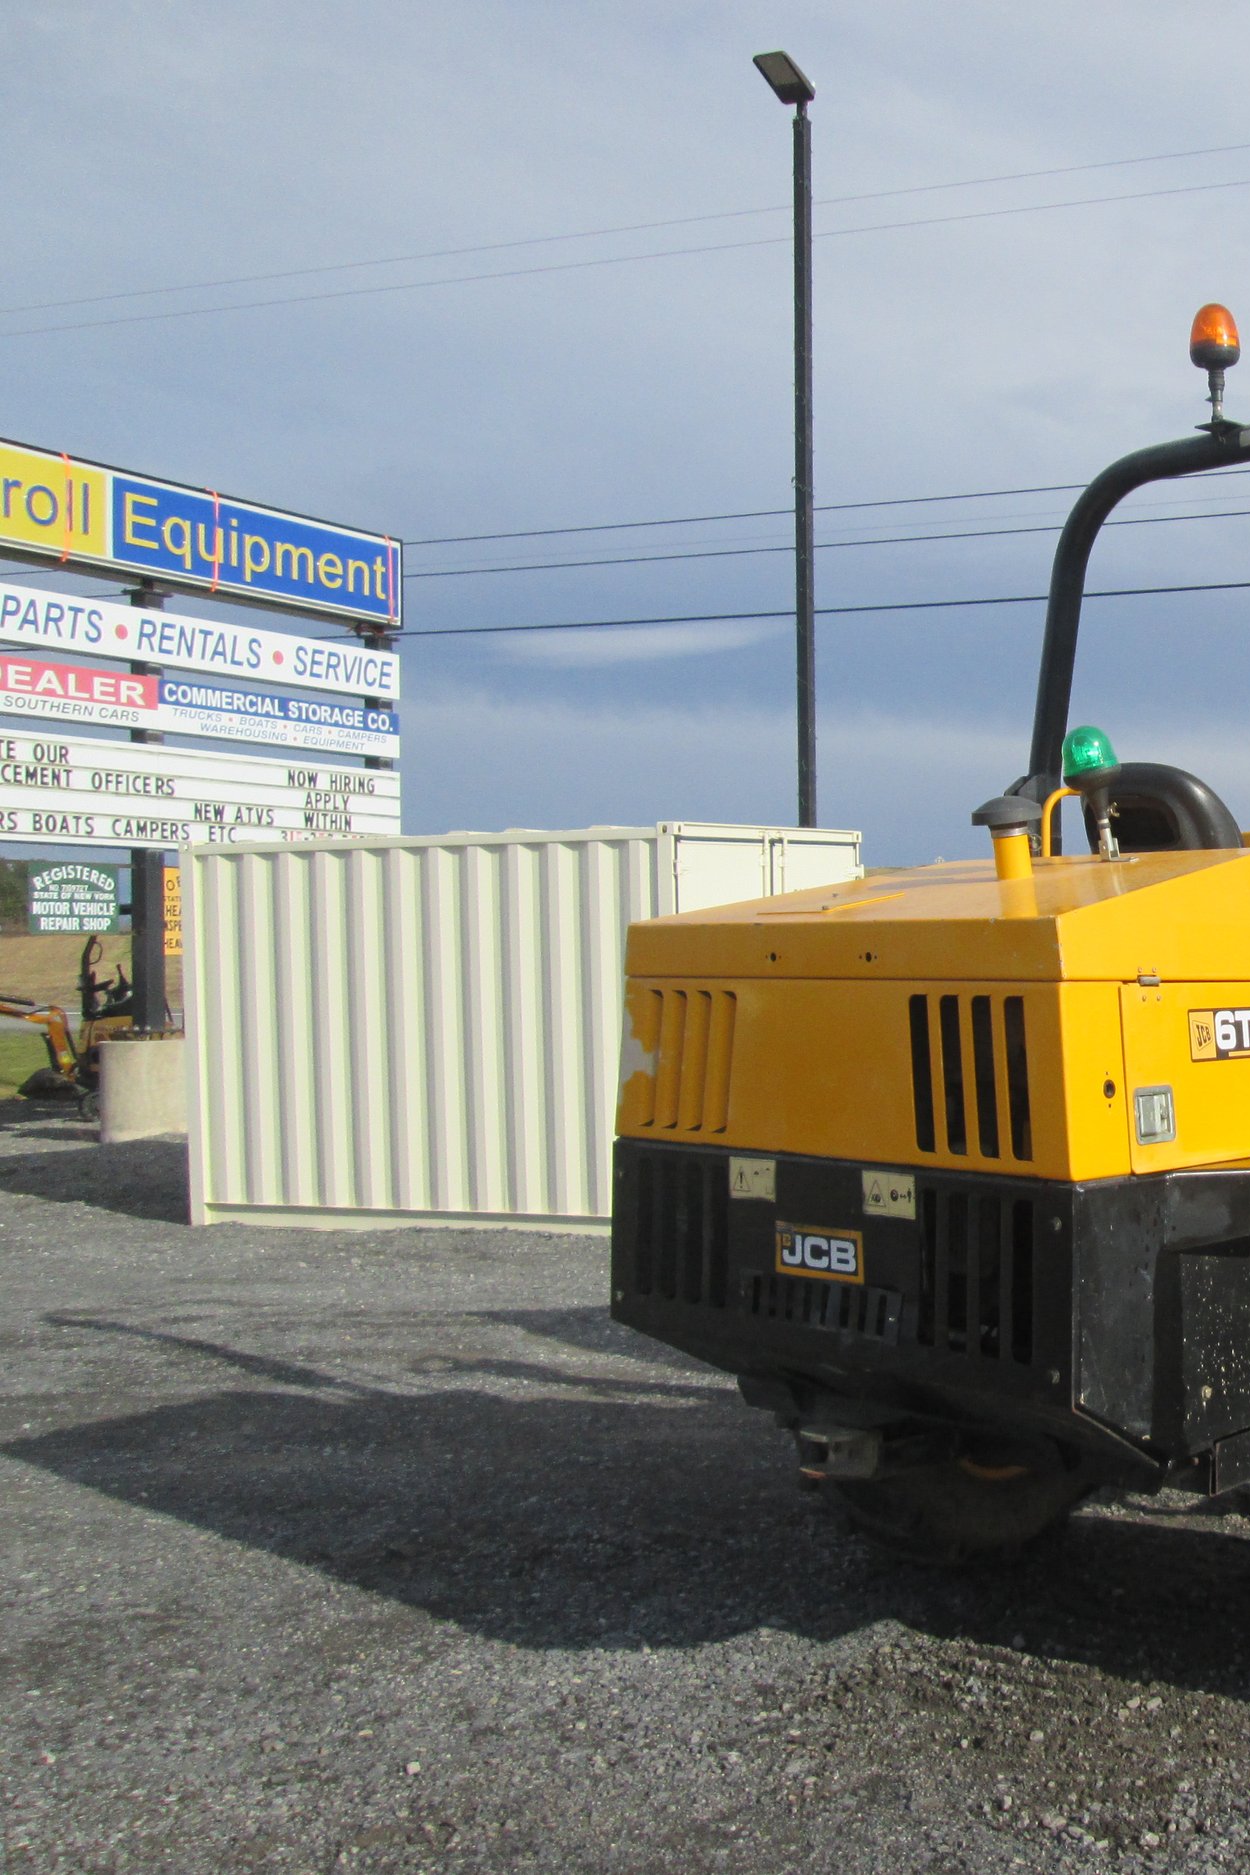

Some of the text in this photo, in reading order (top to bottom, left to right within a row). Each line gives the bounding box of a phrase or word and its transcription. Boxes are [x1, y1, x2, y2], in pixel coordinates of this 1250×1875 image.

[123, 492, 386, 600] Equipment
[0, 593, 393, 690] PARTS RENTALS SERVICE
[0, 664, 145, 706] EALER
[3, 695, 140, 723] SOUTHERN CARS
[164, 683, 394, 732] COMMERCIAL STORAGE CO.
[172, 707, 388, 744] TRUCKS BOATS CARS CAMPERS
[200, 722, 366, 751] WAREHOUSING EQUIPMENT
[33, 743, 69, 764] OUR
[1, 764, 175, 796] CEMENT OFFICERS
[288, 769, 375, 794] NOW HIRING
[194, 803, 274, 826] NEW ATVS
[305, 792, 350, 811] APPLY
[33, 813, 95, 835] BOATS
[112, 818, 190, 840] CAMPERS
[208, 825, 238, 843] ETC
[304, 811, 352, 832] WITHIN
[32, 865, 115, 891] REGISTERED
[32, 891, 115, 901] STATE OF NEW YORK
[32, 901, 117, 916] MOTOR VEHICLE
[40, 917, 111, 931] REPAIR SHOP
[782, 1234, 857, 1273] JCB
